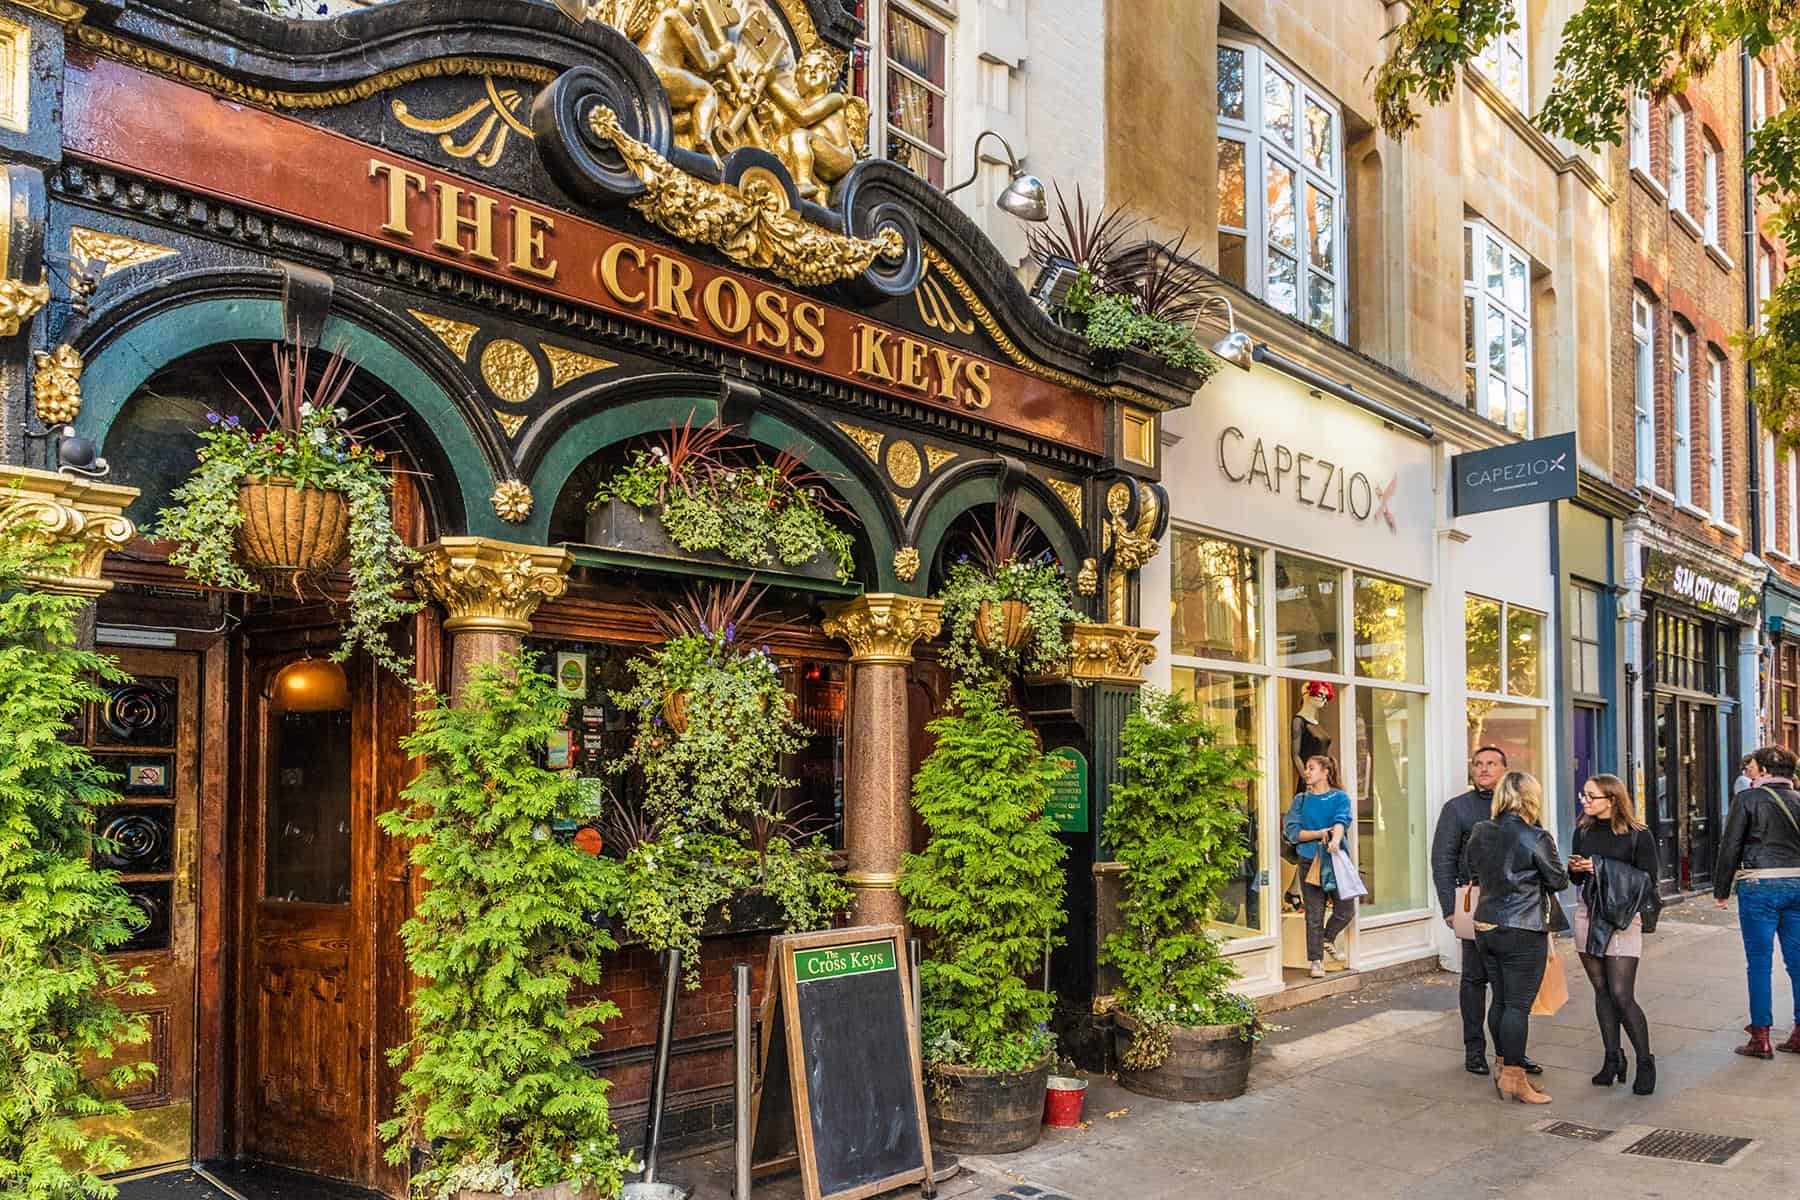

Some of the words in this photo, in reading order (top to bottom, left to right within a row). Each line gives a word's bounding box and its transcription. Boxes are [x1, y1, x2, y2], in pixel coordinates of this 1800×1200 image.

[368, 158, 558, 279] THE
[600, 242, 825, 358] CROSS
[857, 322, 992, 409] KEYS
[1219, 426, 1372, 521] CAPEZIO
[1466, 459, 1549, 487] CAPEZIO
[1694, 575, 1715, 604] CITY
[807, 957, 847, 974] Cross
[850, 951, 884, 969] Keys
[824, 950, 839, 959] The
